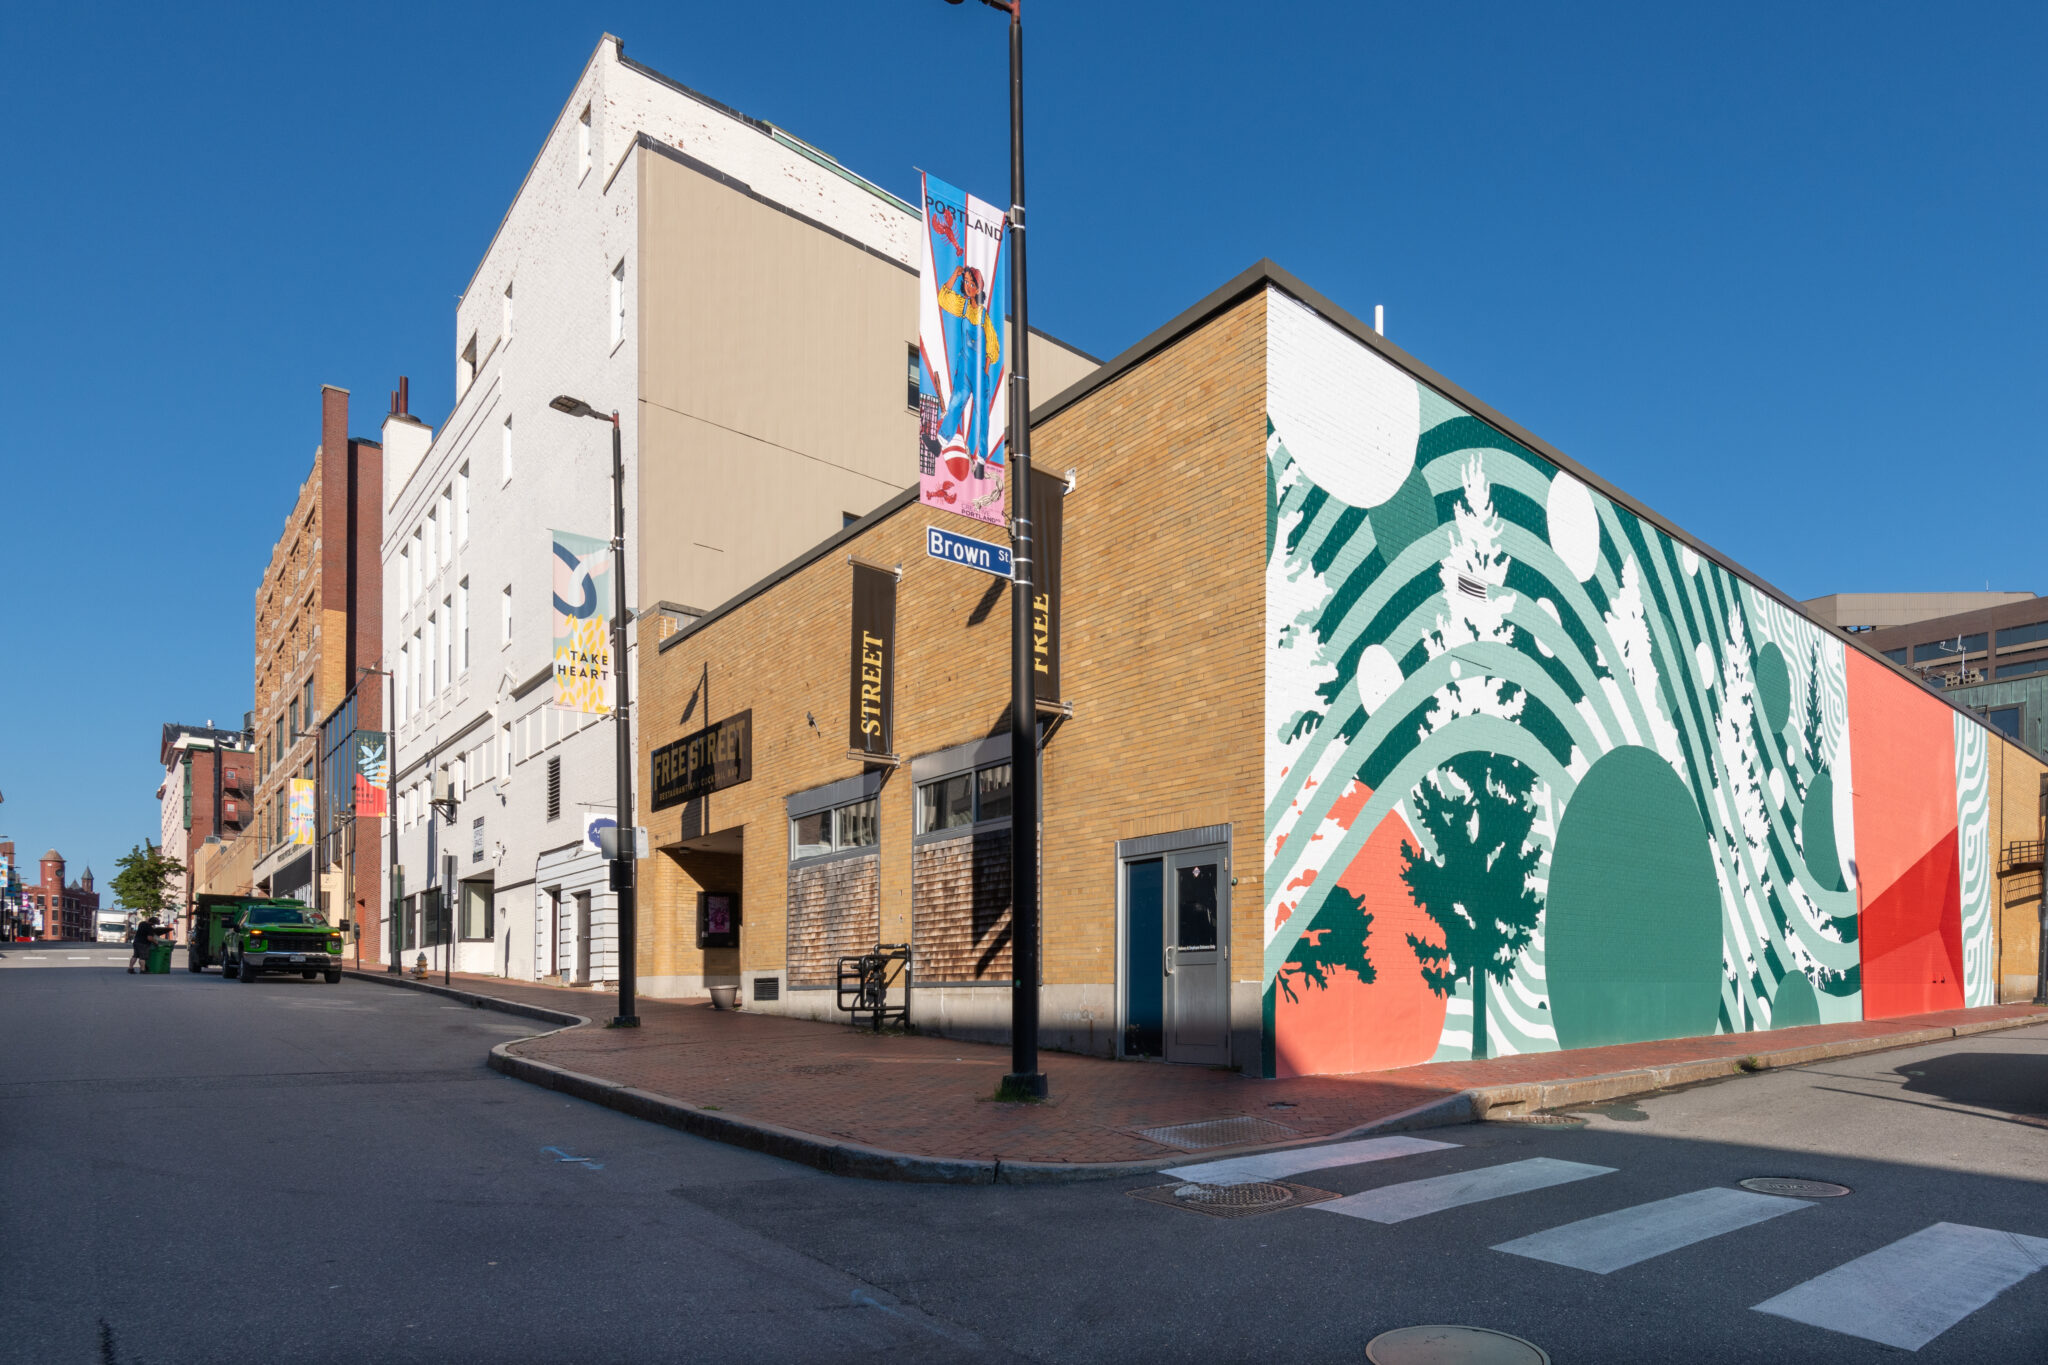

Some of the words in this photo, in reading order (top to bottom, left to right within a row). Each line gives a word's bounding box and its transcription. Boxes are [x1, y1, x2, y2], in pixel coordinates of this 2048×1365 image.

[925, 195, 1003, 242] PORTLAND
[930, 531, 990, 568] Brown
[557, 664, 609, 681] HEART
[570, 650, 608, 666] TAKE
[861, 630, 883, 737] STREET
[654, 744, 687, 792] FREE
[688, 719, 745, 771] STREET
